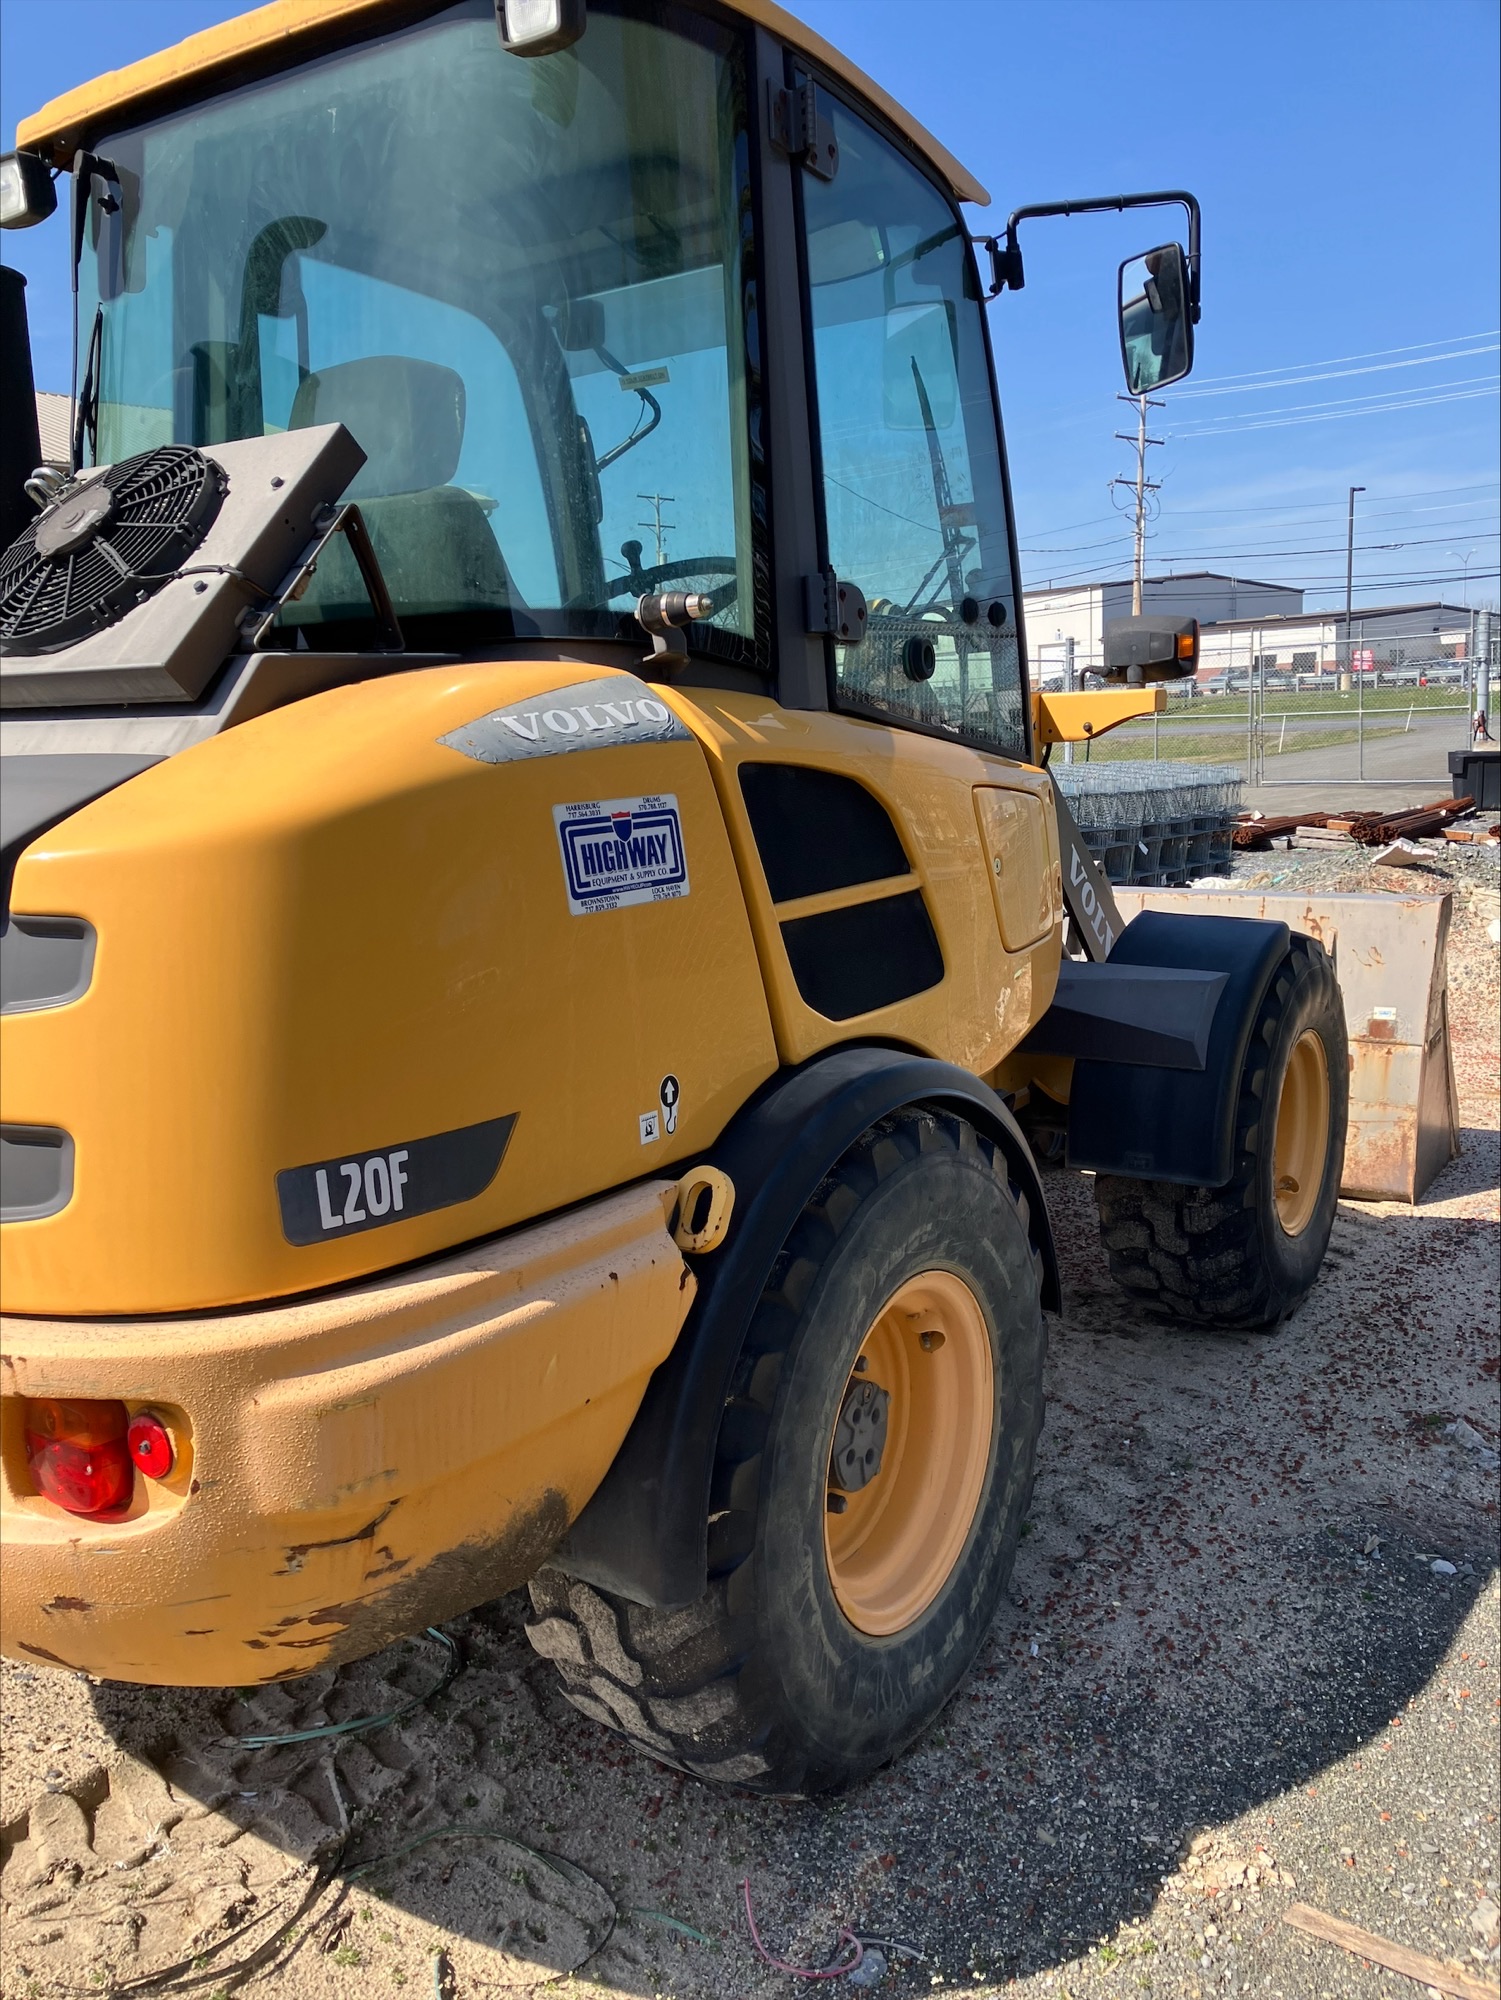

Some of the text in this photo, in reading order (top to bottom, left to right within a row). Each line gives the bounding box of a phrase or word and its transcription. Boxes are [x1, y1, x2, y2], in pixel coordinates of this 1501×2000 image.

[493, 699, 669, 741] VOLVO
[565, 802, 601, 812] HARRISBURG
[580, 833, 667, 876] HIGHWAY
[592, 874, 628, 887] EQUIPMENT
[637, 870, 656, 879] SUPPLY
[658, 868, 668, 876] CO.
[651, 884, 681, 895] LOCK HAVEN
[580, 895, 620, 907] BROWNSTOWN
[1070, 843, 1114, 958] VOLV
[315, 1150, 409, 1230] L20F
